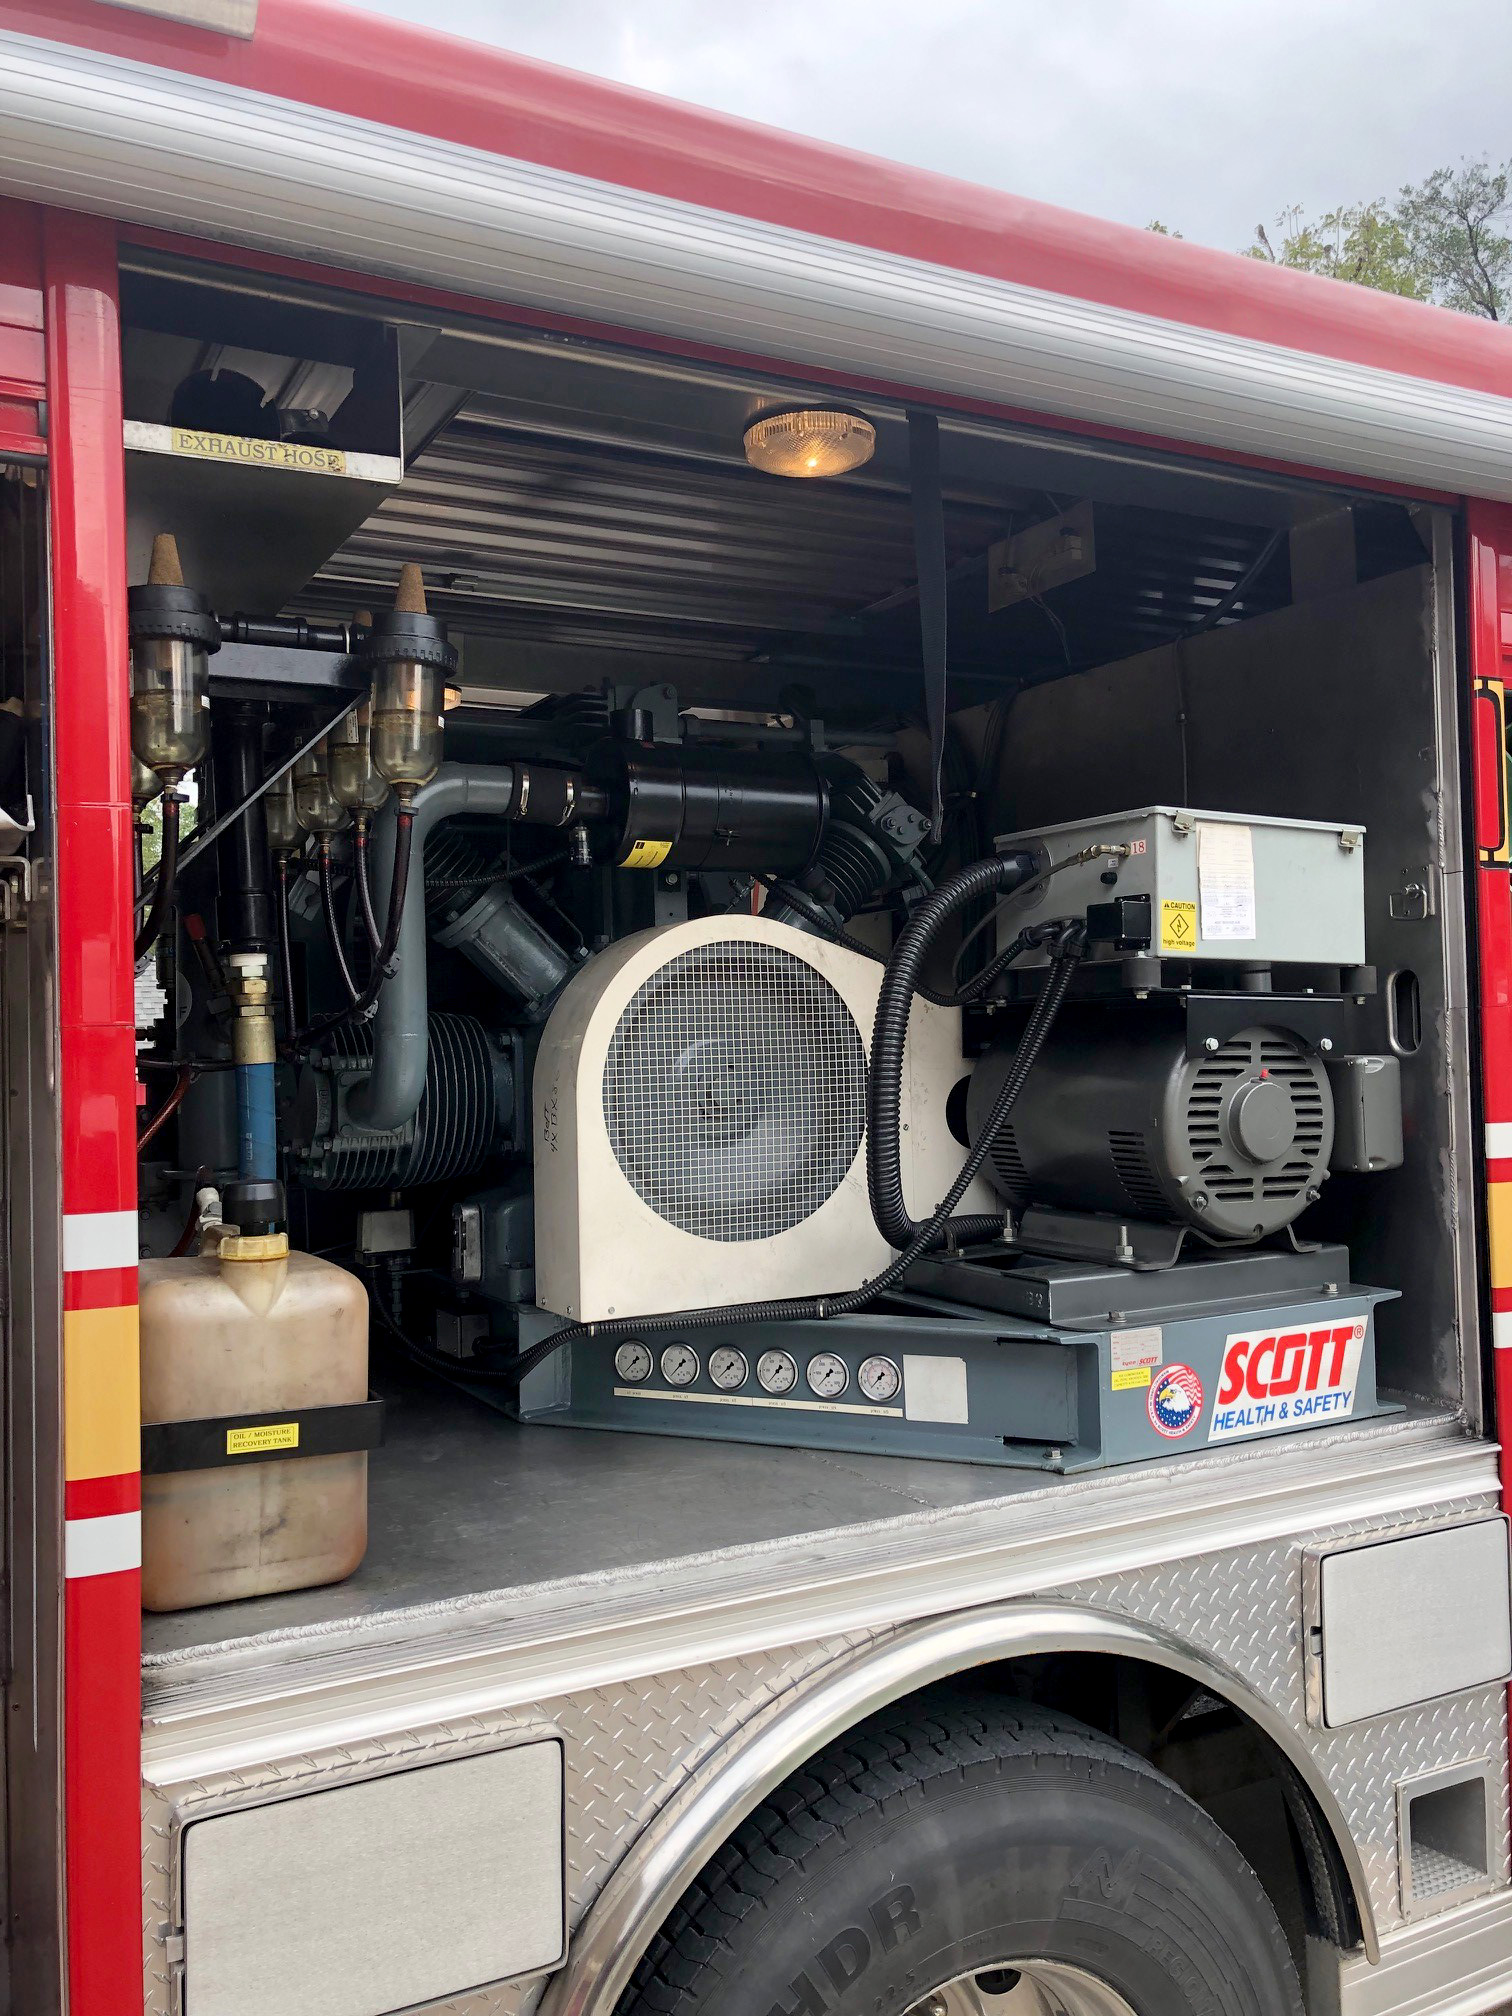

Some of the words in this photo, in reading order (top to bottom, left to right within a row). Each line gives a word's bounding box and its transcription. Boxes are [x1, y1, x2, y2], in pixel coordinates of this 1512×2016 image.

[178, 433, 277, 460] EXHAUST
[284, 449, 340, 472] HOSE
[1132, 841, 1145, 854] 18
[1170, 902, 1196, 910] CAUTION
[1163, 938, 1174, 947] high
[1176, 939, 1195, 947] voltage
[1139, 1356, 1159, 1365] SCOTT
[1218, 1325, 1355, 1405] SCOTT
[1213, 1404, 1275, 1432] HEALTH
[1279, 1401, 1288, 1420] &
[1293, 1391, 1352, 1416] SAFETY
[254, 1429, 291, 1438] MOISTURE
[233, 1438, 272, 1448] RECOVERY
[273, 1436, 292, 1444] TANK
